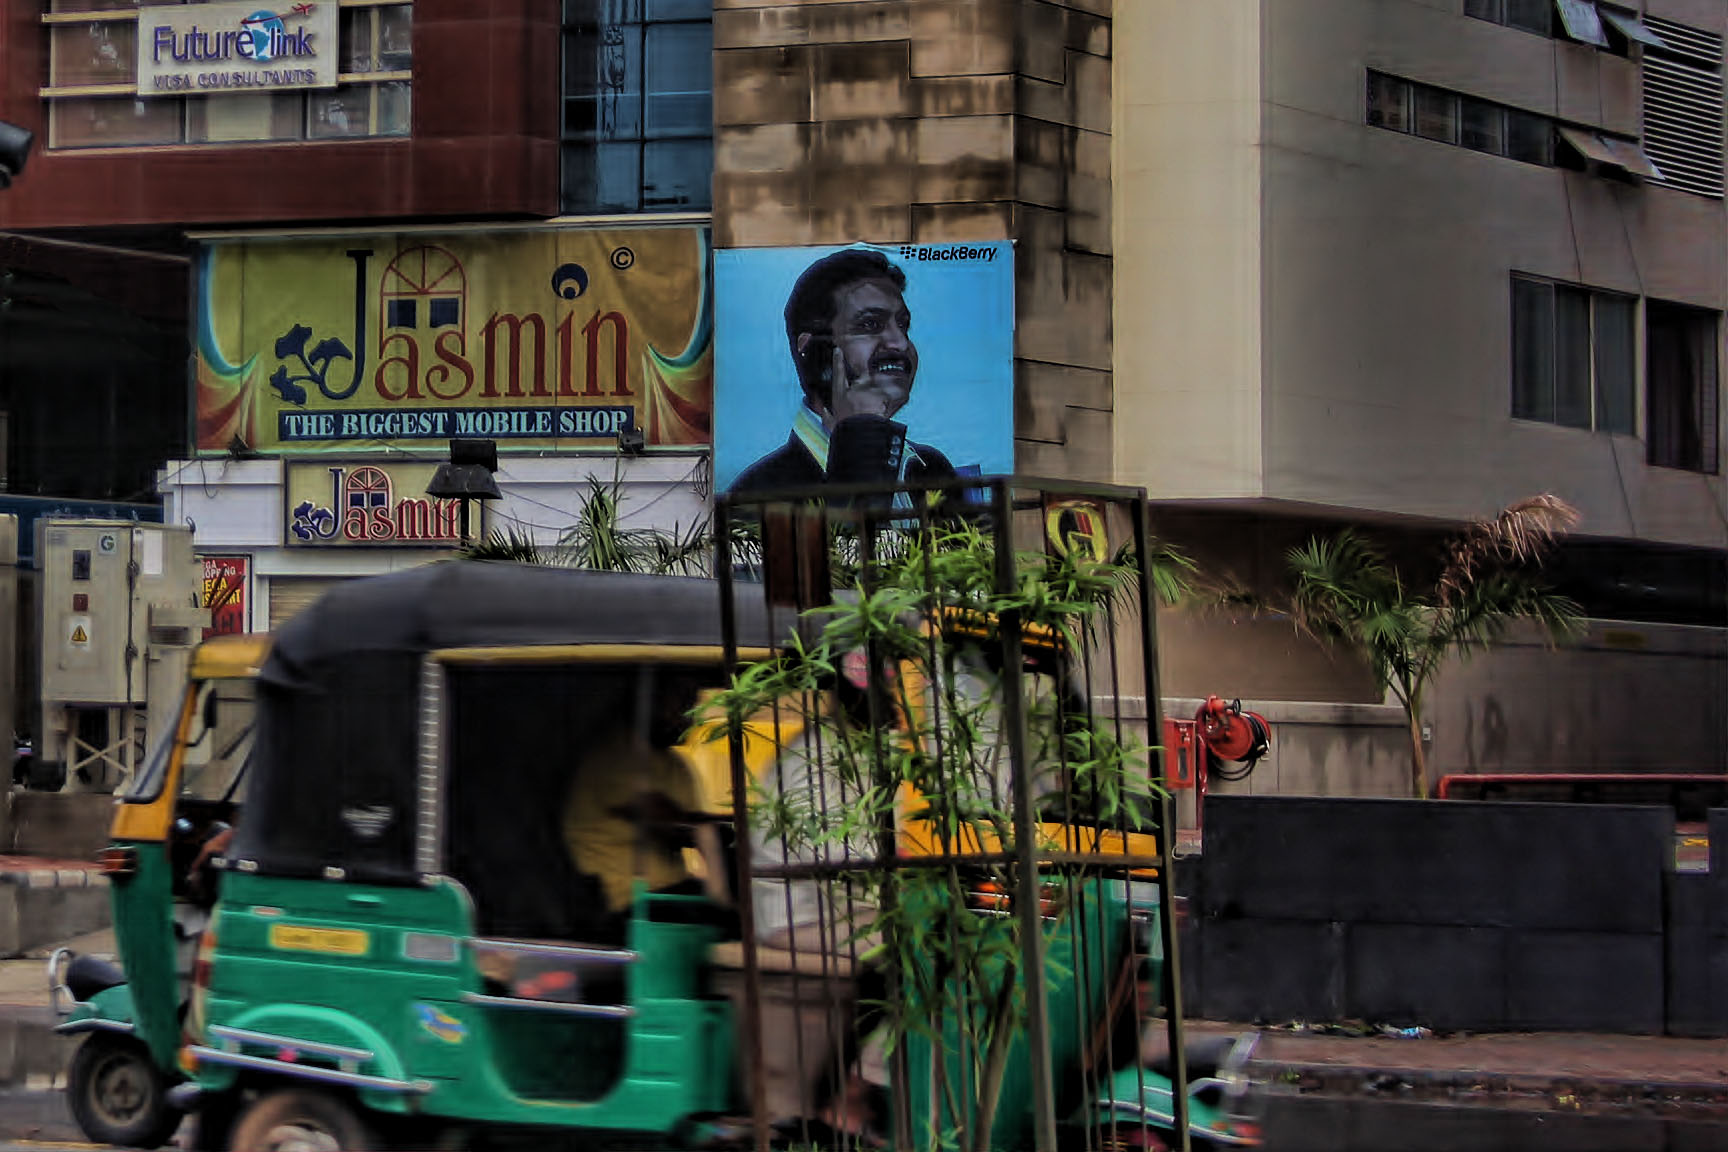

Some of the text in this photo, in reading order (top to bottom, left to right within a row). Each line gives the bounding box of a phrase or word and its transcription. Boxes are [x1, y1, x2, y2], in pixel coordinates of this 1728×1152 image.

[154, 69, 316, 89] VISA CONSULTANTS
[918, 246, 997, 262] BlackBerry
[308, 247, 635, 401] Jasmin
[285, 408, 628, 436] THE BIGGEST MOBILE SHOP
